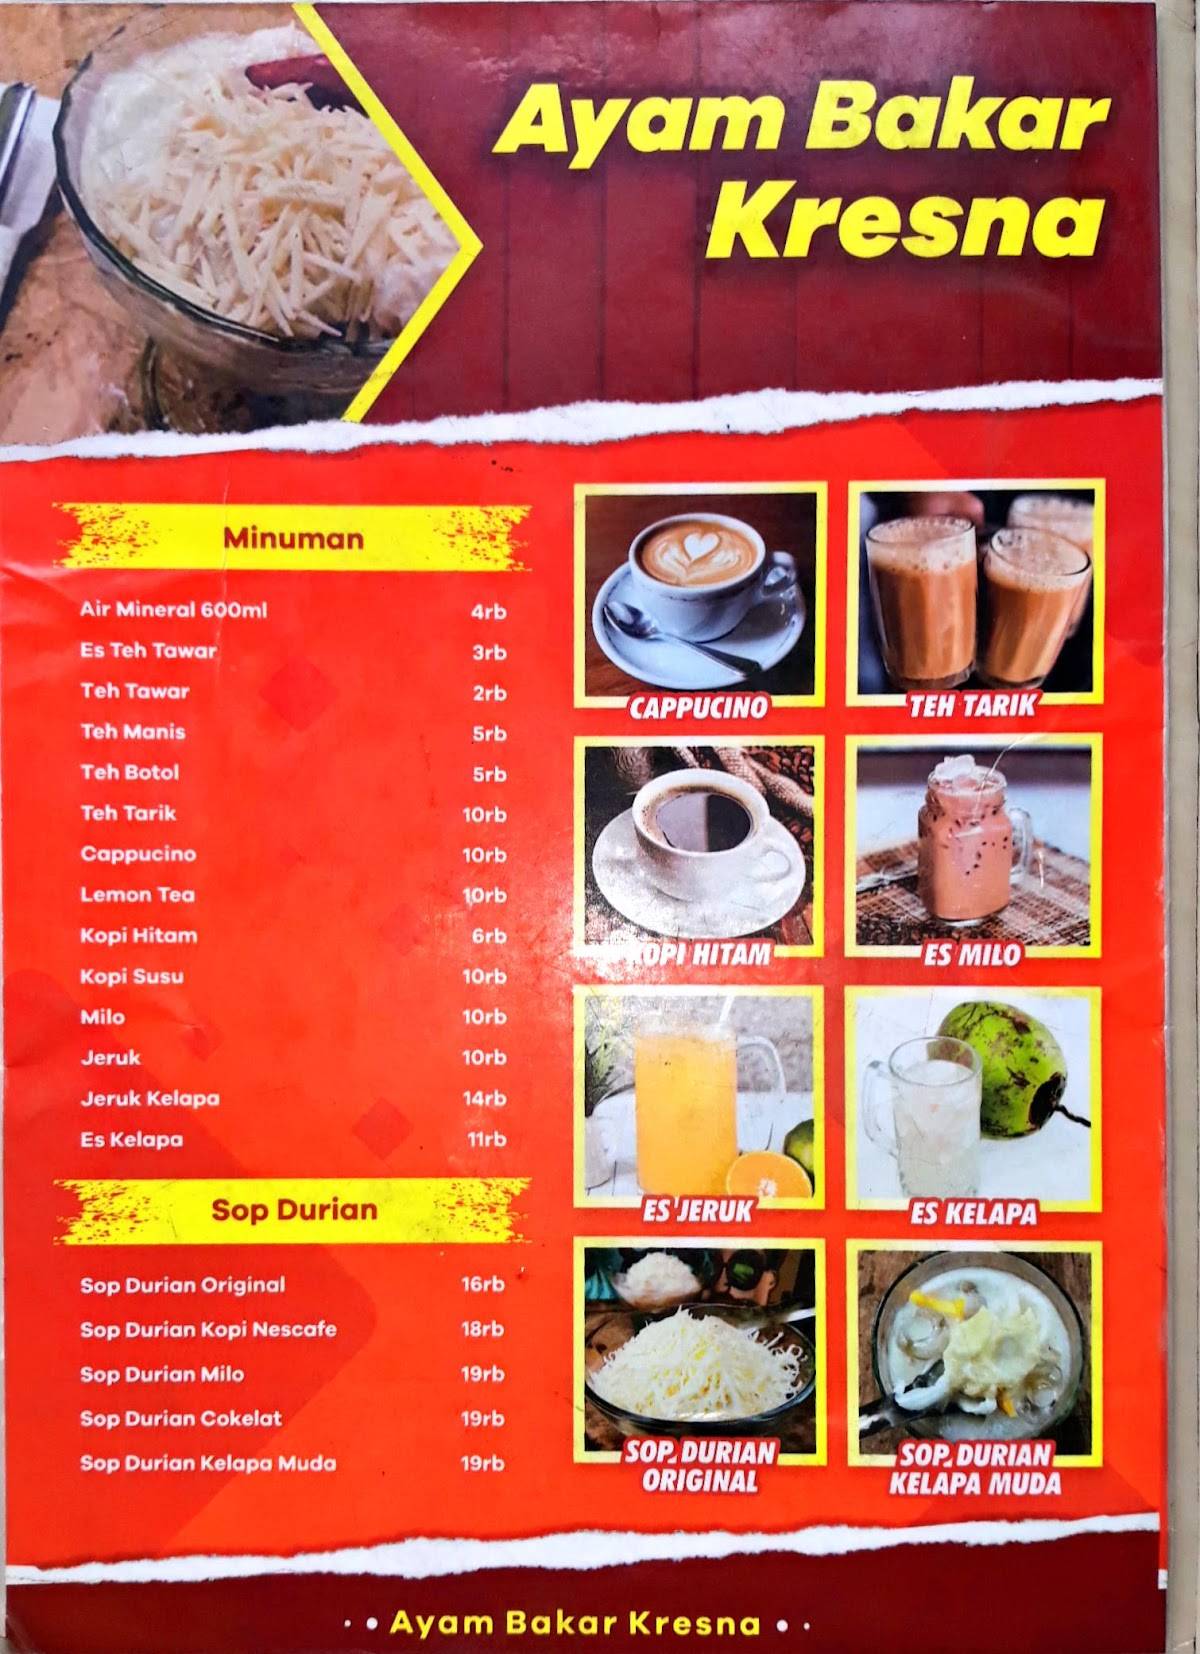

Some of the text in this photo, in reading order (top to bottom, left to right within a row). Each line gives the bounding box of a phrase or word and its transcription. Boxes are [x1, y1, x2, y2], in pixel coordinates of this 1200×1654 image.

[492, 76, 1111, 169] Ayam Bakar
[706, 181, 1105, 258] Kresna
[225, 526, 363, 549] Minuman
[80, 601, 267, 618] Air Mineral 600ml
[471, 603, 507, 620] 4rb
[80, 642, 217, 659] Es Teh Tawar
[473, 644, 507, 661] 3rb
[81, 682, 190, 699] Teh Tawar
[473, 684, 507, 701] 2rb
[630, 697, 768, 720] CAPPUCINO
[910, 694, 1036, 718] TEH TARIK
[81, 723, 186, 740] Teh Manis
[473, 725, 507, 742] 5rb
[80, 763, 179, 780] Teh Botol
[473, 766, 507, 782] 5rb
[81, 804, 176, 821] Teh Tarik
[463, 806, 507, 823] 10rb
[80, 845, 197, 865] Cappucino
[463, 846, 507, 863] 10rb
[80, 886, 195, 903] Lemon Tea
[462, 886, 508, 903] 10rb
[80, 928, 198, 946] Kopi Hitam
[471, 927, 508, 945] 6rb
[692, 943, 771, 966] HITAM
[924, 944, 1022, 966] ES MILO
[80, 968, 184, 987] Kopi Susu
[462, 967, 508, 985] 10rb
[80, 1008, 125, 1025] Milo
[462, 1007, 507, 1025] 10rb
[81, 1049, 140, 1066] Jeruk
[462, 1048, 507, 1066] 10rb
[81, 1090, 220, 1109] Jeruk Kelapa
[463, 1089, 507, 1107] 14rb
[80, 1131, 183, 1150] Es Kelapa
[467, 1131, 507, 1147] 11rb
[213, 1197, 377, 1225] Sop Durian
[644, 1200, 754, 1223] ES JERUK
[911, 1202, 1038, 1226] ES KELAPA
[80, 1276, 285, 1297] Sop Durian Original
[462, 1275, 505, 1292] 16rb
[80, 1320, 337, 1341] Sop Durian Kopi Nescafe
[462, 1320, 505, 1337] 18rb
[80, 1365, 245, 1386] Sop Durian Milo
[462, 1365, 505, 1382] 19rb
[80, 1410, 282, 1430] Sop Durian Cokelat
[461, 1410, 505, 1426] 19rb
[626, 1440, 776, 1464] SOP DURIAN
[901, 1442, 1051, 1466] SOP DURIAN
[80, 1454, 337, 1474] Sop Durian Kelapa Muda
[461, 1455, 505, 1471] 19rb
[642, 1468, 758, 1493] ORIGINAL
[890, 1472, 1062, 1496] KELAPA MUDA
[390, 1610, 759, 1639] Ayam Bakar Kresna
